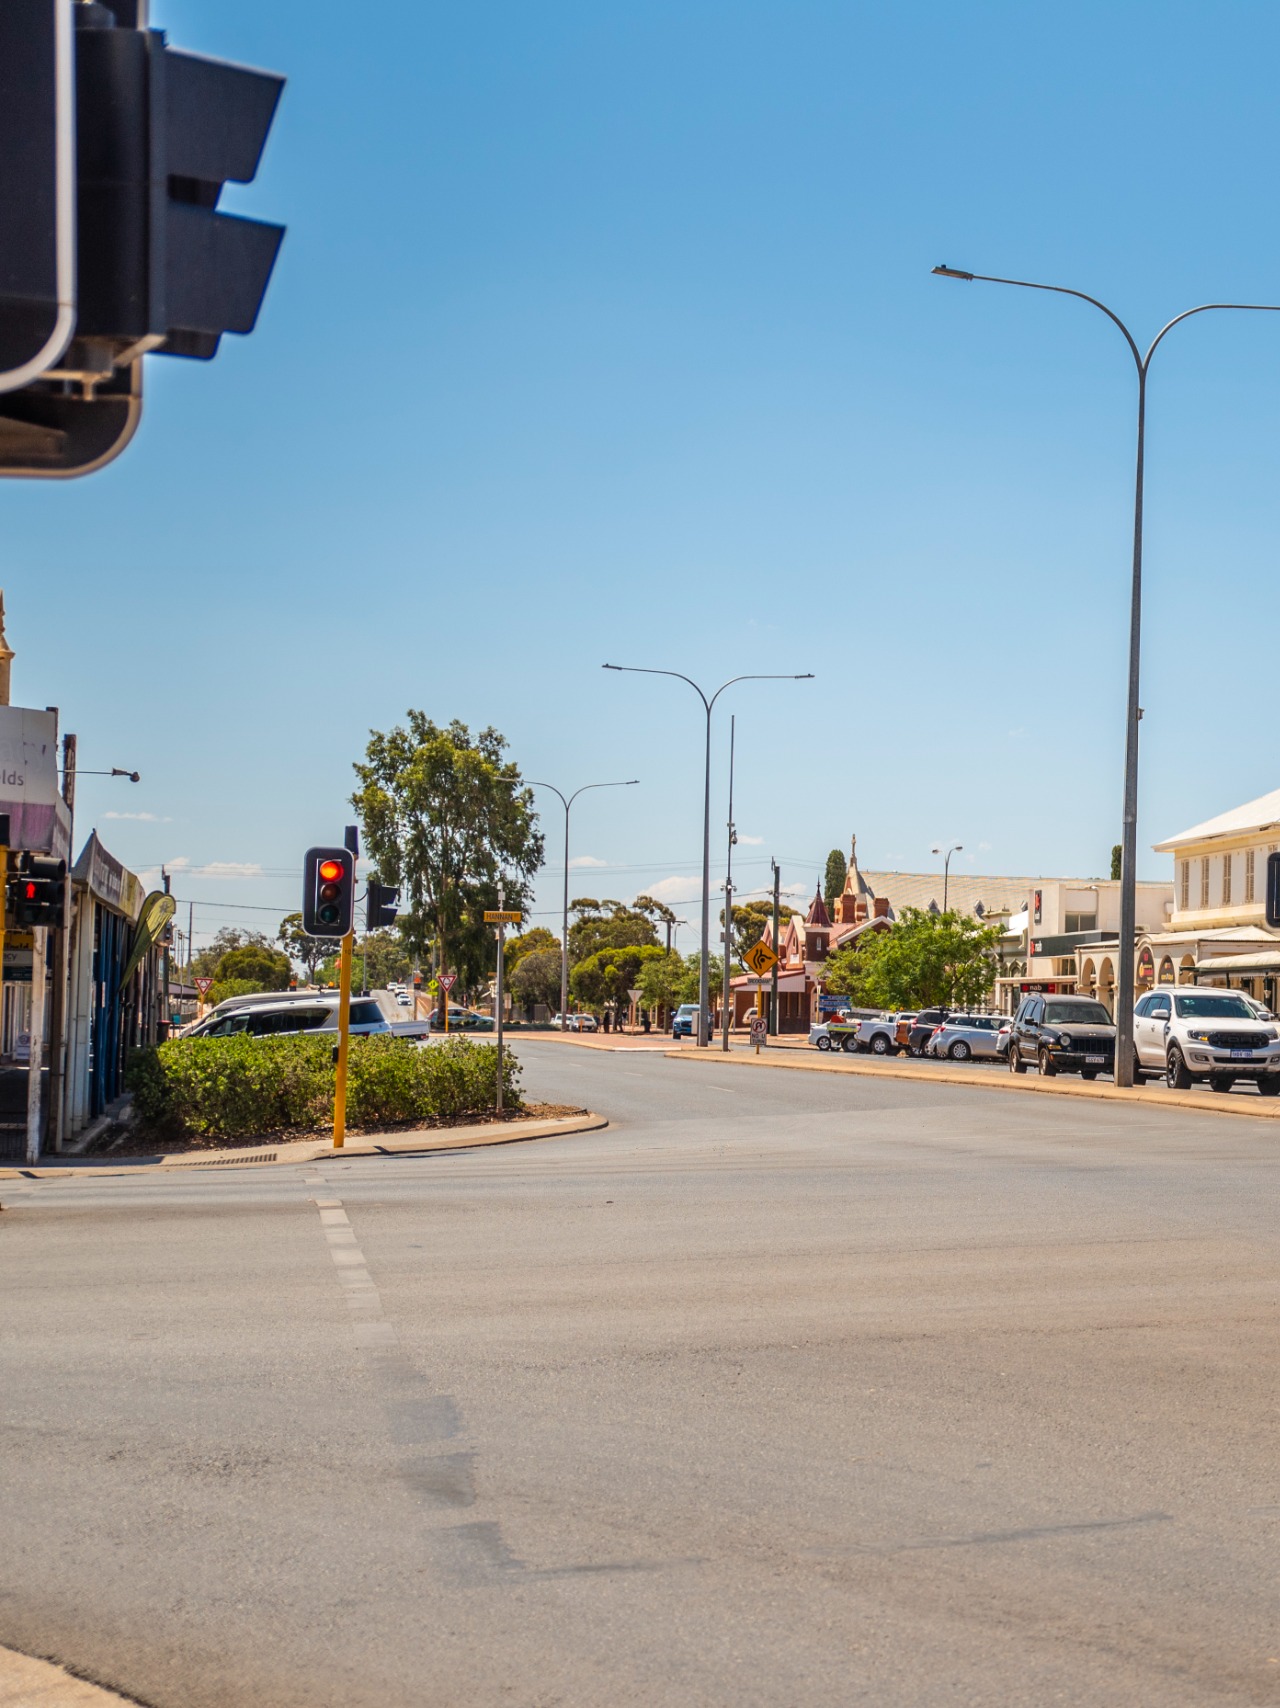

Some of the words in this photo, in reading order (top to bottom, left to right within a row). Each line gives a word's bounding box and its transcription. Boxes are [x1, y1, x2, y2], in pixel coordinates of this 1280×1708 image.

[0, 769, 24, 786] lds
[486, 912, 513, 920] HANNAN
[1029, 983, 1042, 991] nab
